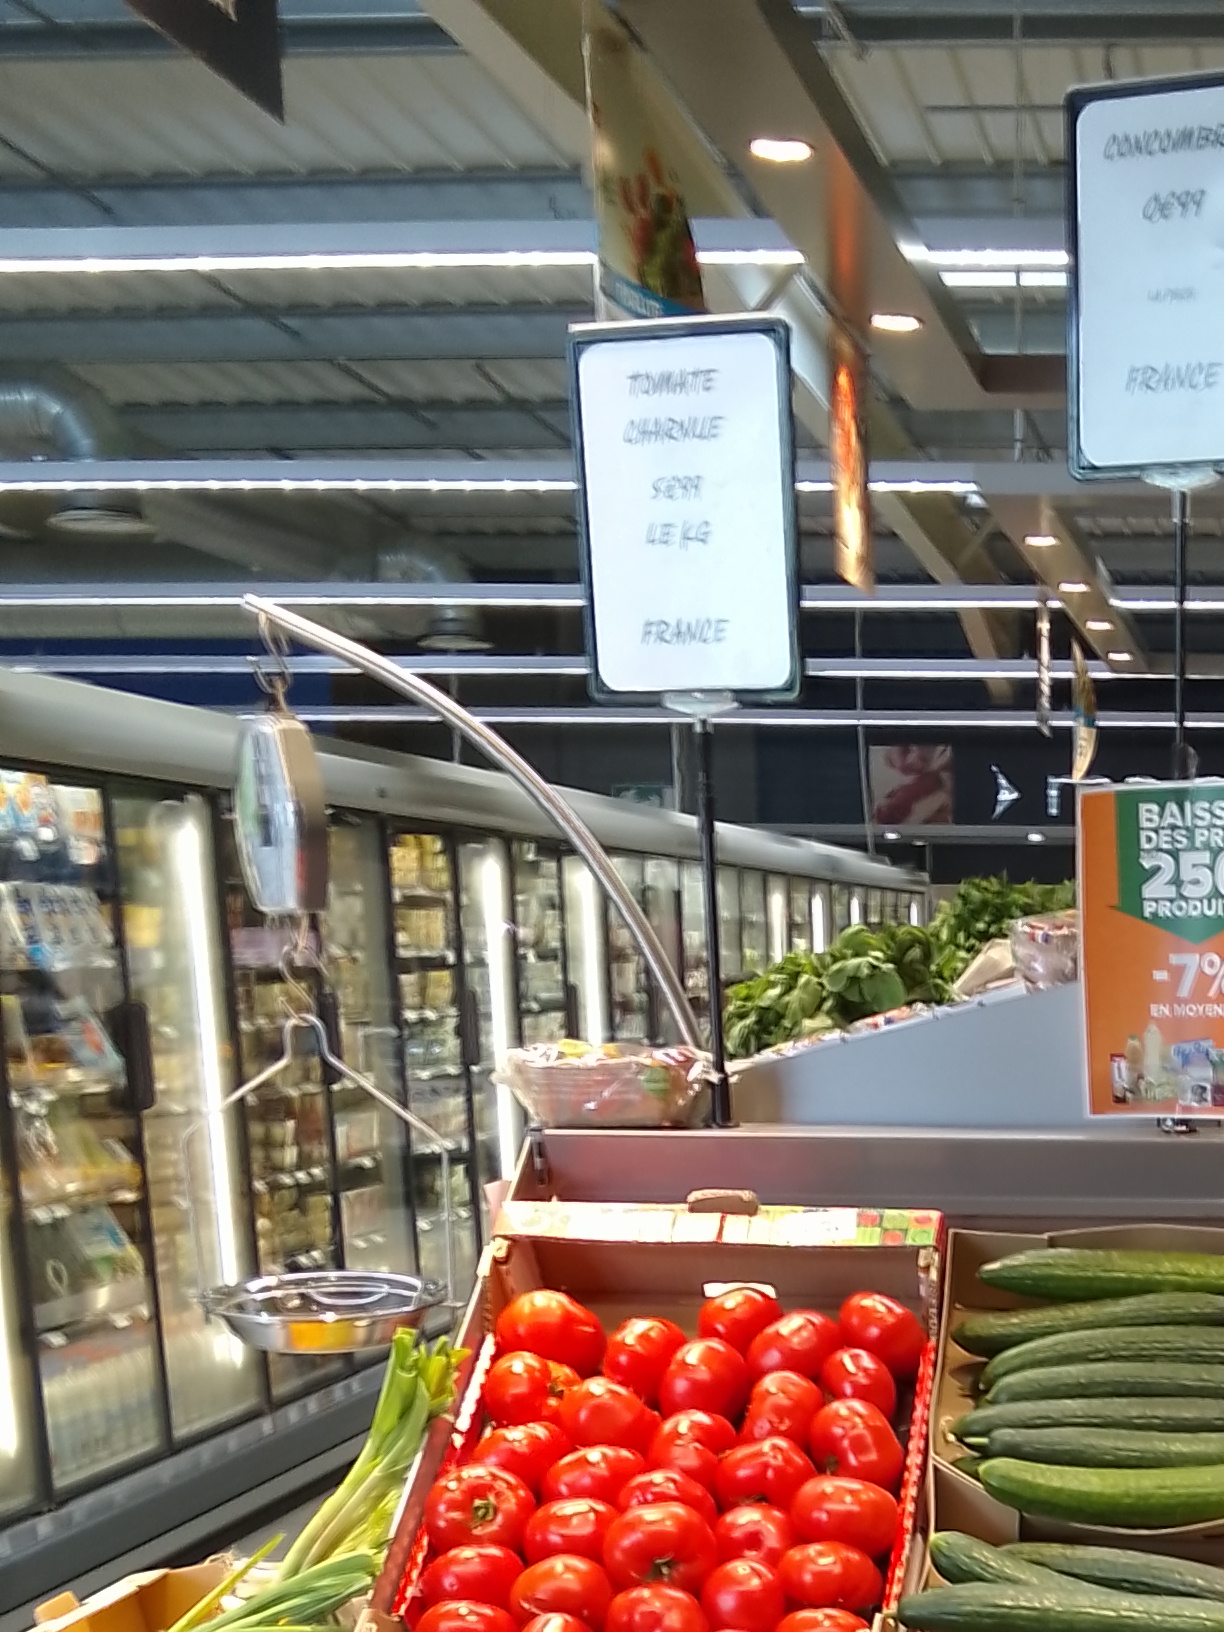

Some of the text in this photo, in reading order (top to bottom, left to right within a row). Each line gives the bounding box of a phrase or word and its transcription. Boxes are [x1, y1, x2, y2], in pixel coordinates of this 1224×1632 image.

[1125, 362, 1223, 394] FRANCE
[645, 520, 713, 549] LE KG
[641, 617, 731, 645] FRANCE
[1139, 828, 1187, 850] DES
[1150, 1004, 1169, 1018] EN
